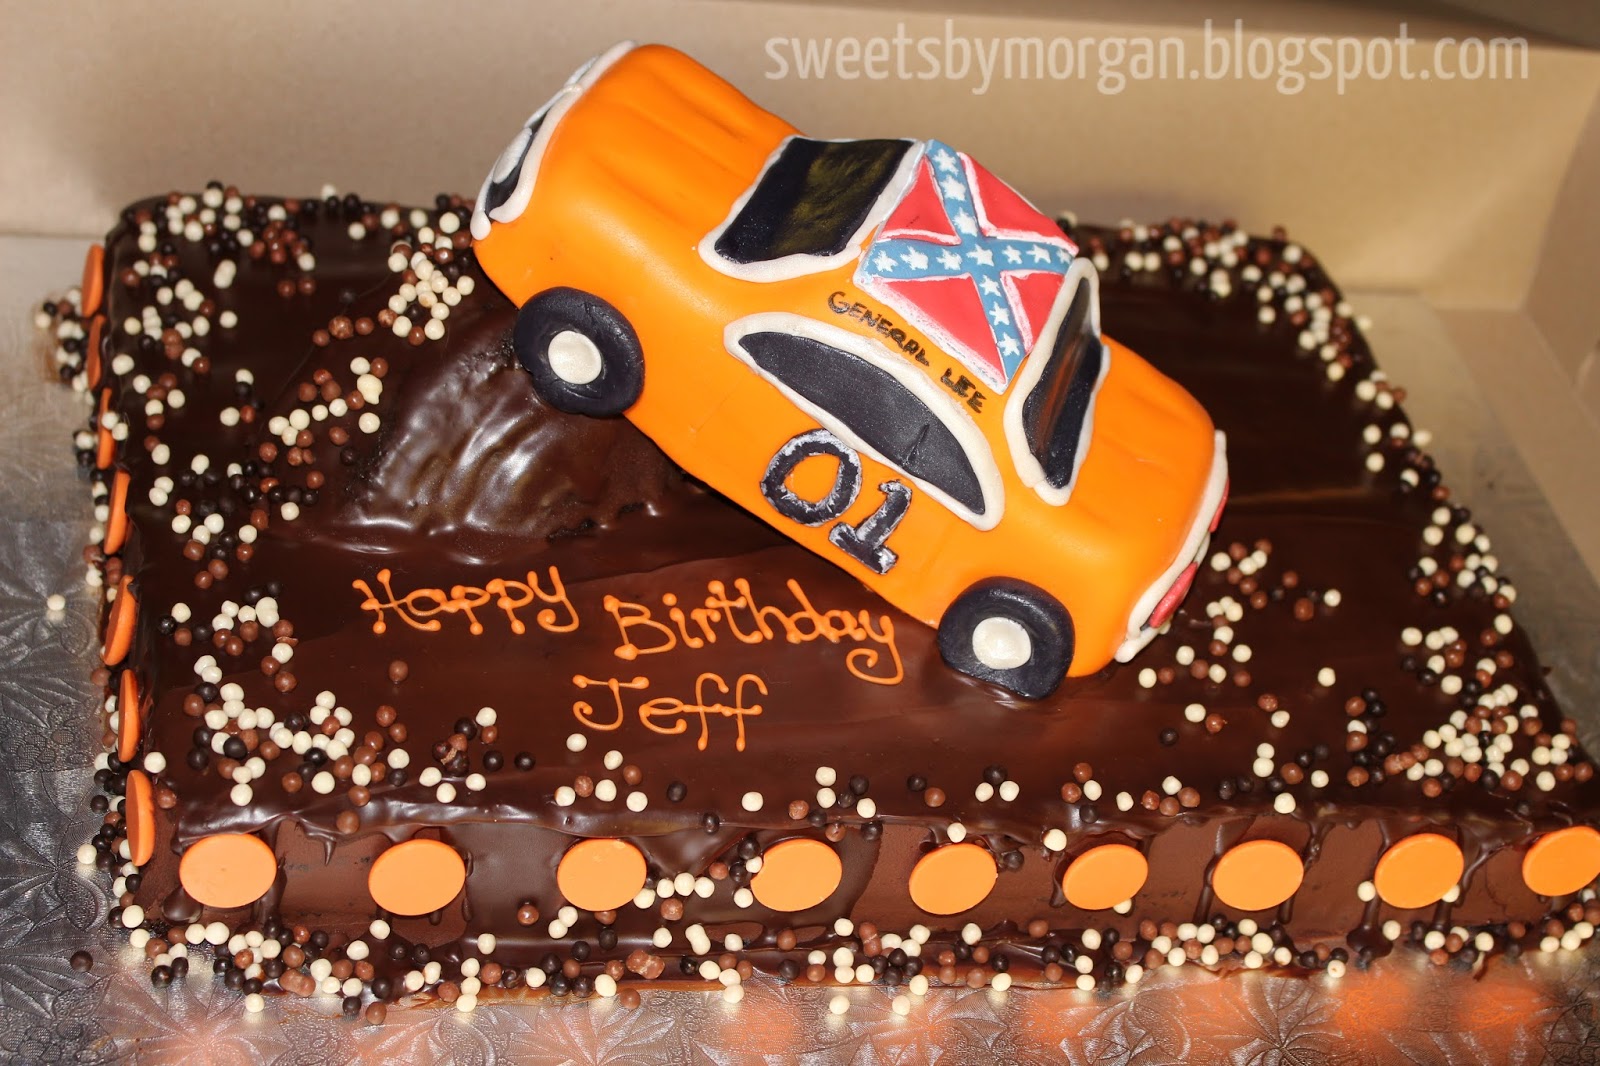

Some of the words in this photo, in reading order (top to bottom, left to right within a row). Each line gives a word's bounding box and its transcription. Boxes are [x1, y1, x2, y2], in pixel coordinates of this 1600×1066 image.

[827, 290, 930, 367] GENERAL
[939, 368, 987, 414] LEE
[759, 427, 913, 575] 01
[352, 565, 580, 636] Happy
[603, 577, 904, 686] Birthday
[572, 672, 769, 752] Jeff
